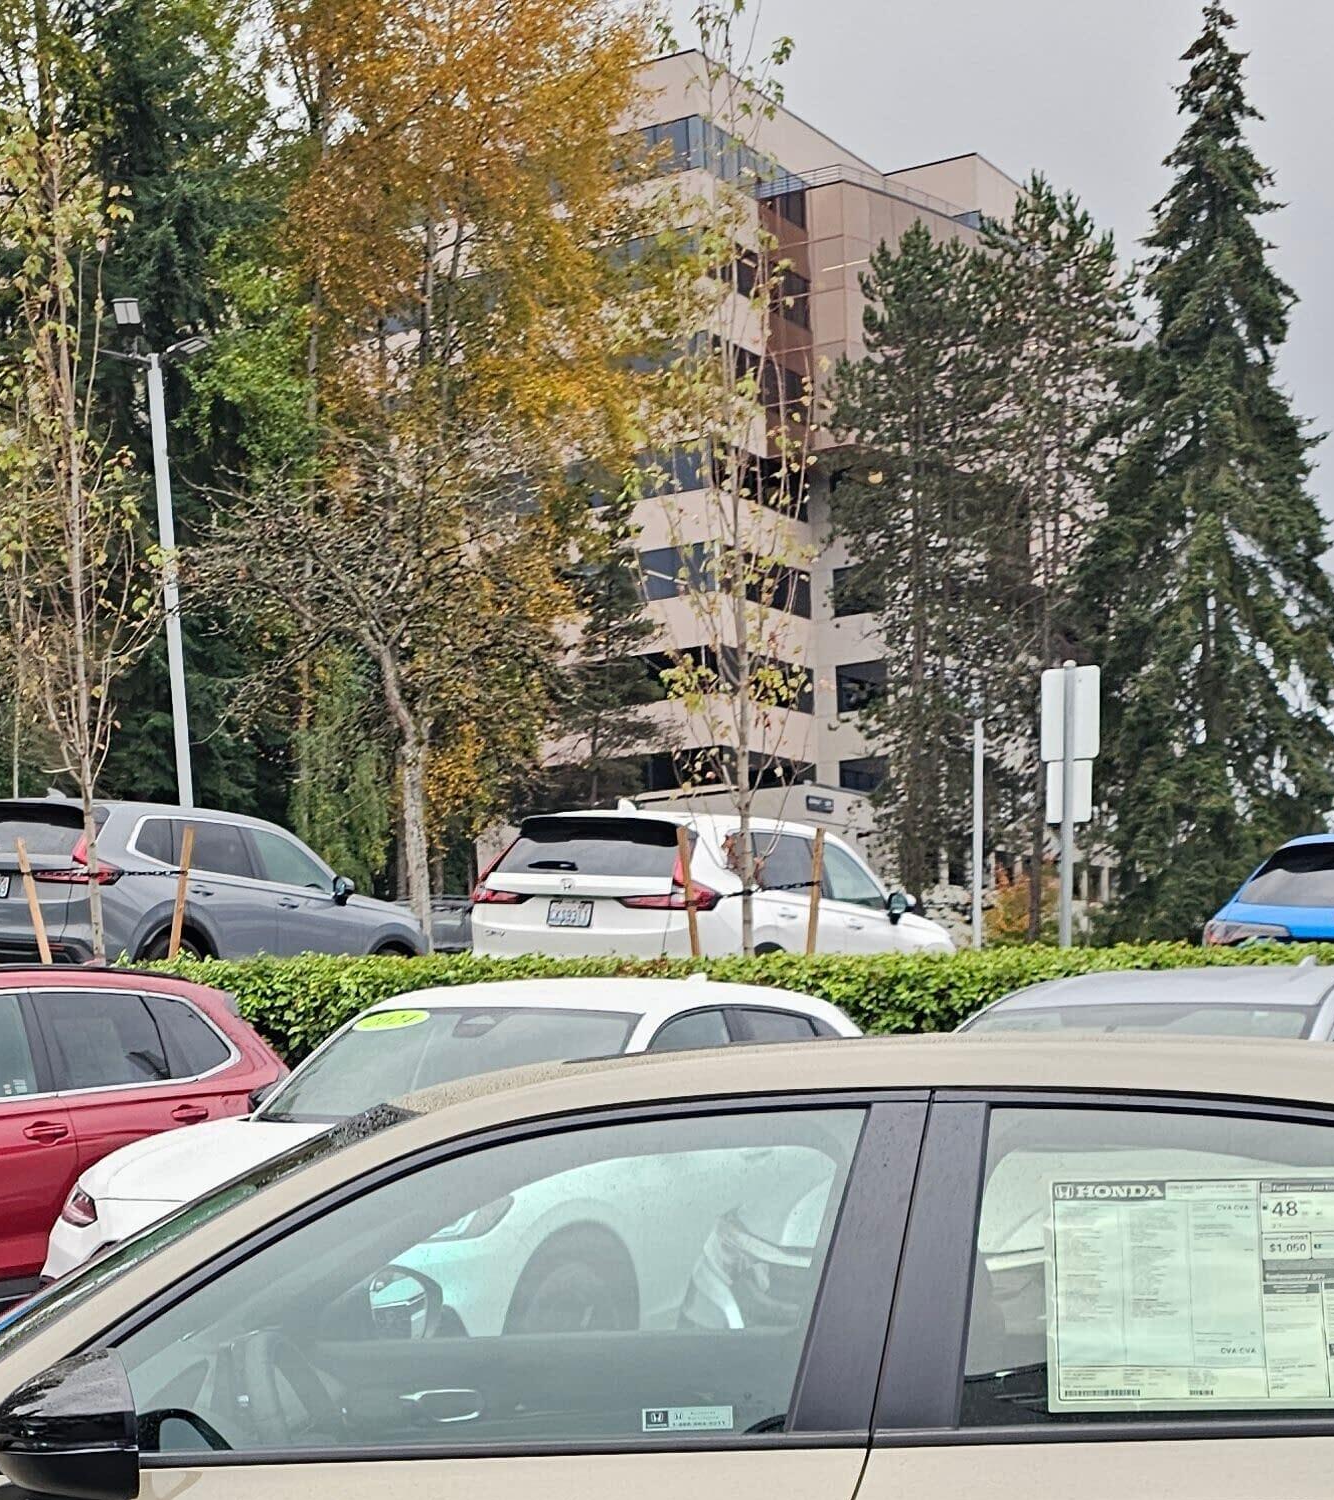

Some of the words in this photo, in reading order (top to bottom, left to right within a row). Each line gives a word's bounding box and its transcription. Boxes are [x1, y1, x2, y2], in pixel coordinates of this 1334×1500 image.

[1076, 1185, 1163, 1198] HONDA
[1272, 1201, 1298, 1217] 48
[1269, 1243, 1306, 1252] $1,050
